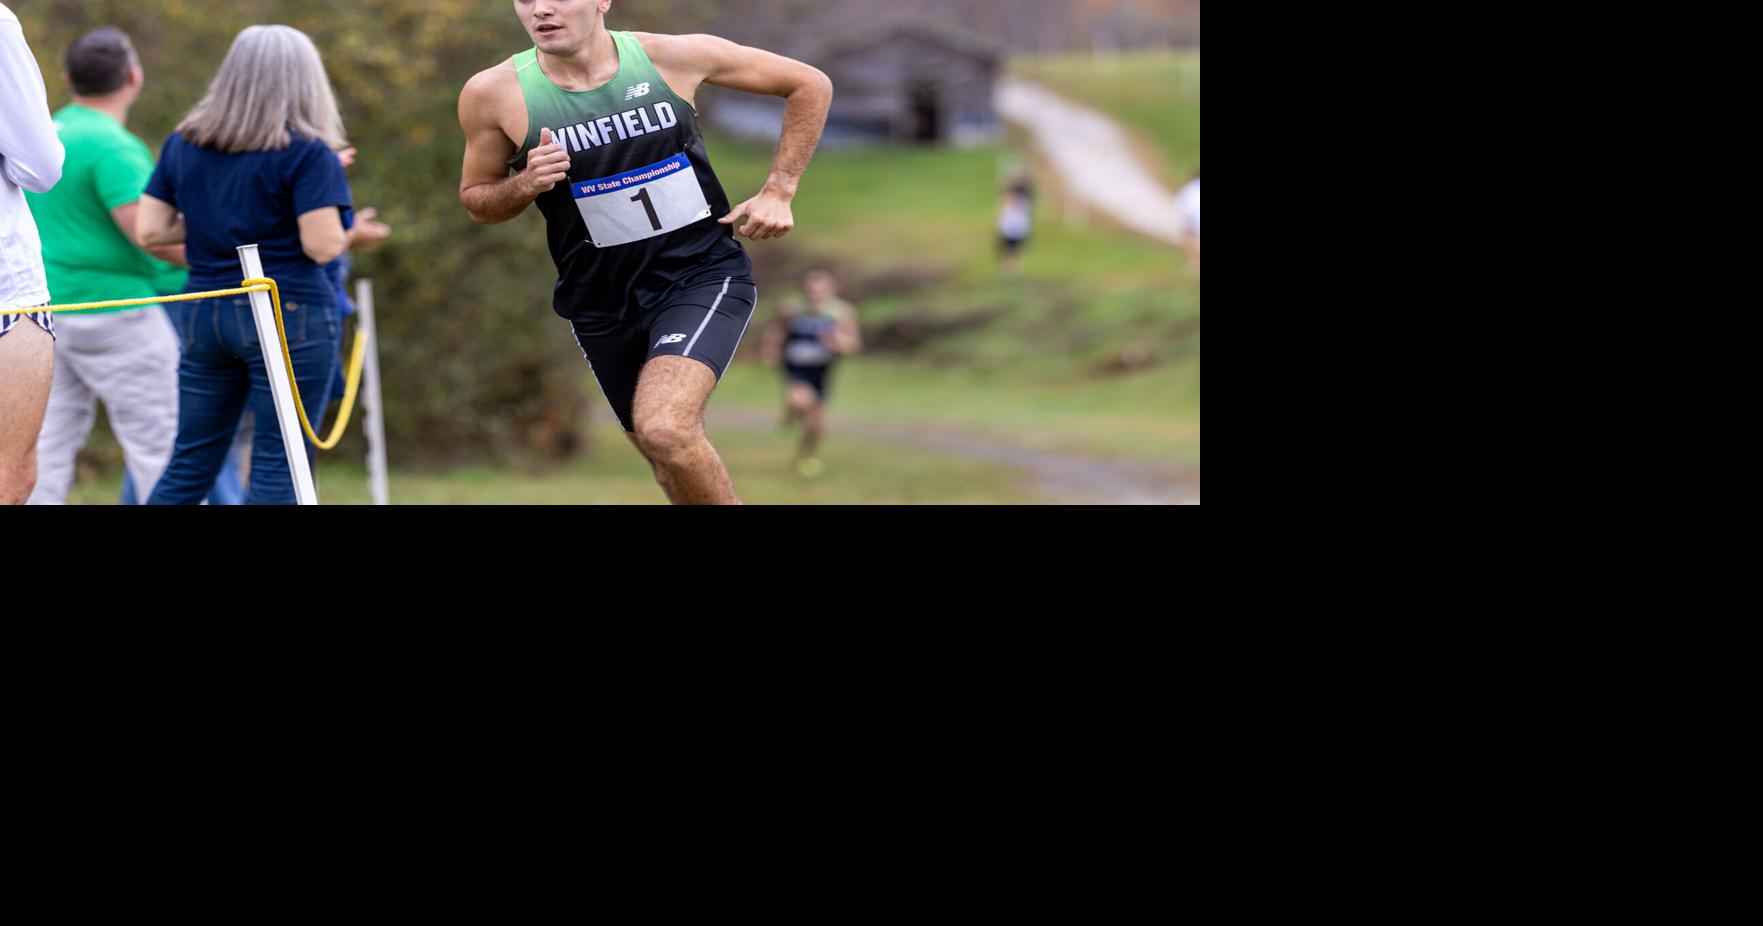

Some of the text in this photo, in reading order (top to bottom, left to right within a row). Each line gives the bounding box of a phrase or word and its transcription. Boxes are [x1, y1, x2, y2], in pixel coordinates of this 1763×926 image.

[581, 161, 681, 194] WV State Championship
[630, 187, 663, 232] 1
